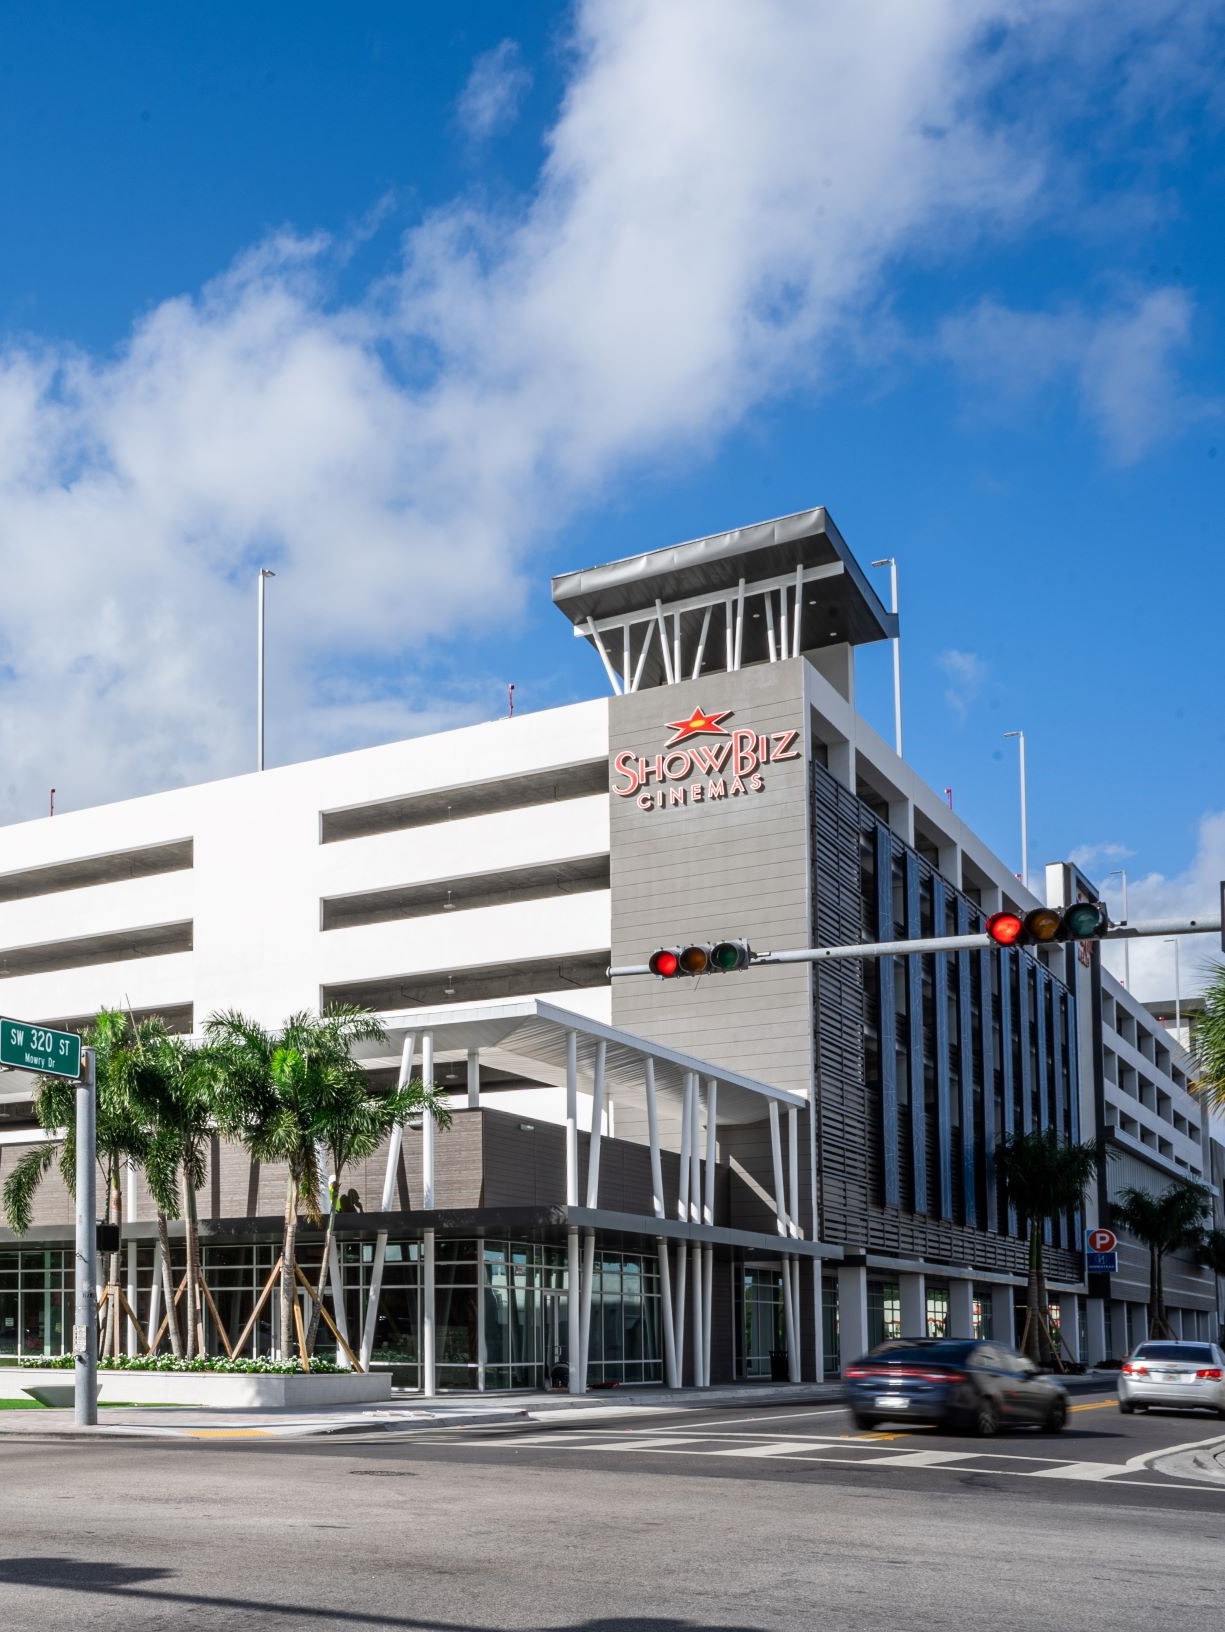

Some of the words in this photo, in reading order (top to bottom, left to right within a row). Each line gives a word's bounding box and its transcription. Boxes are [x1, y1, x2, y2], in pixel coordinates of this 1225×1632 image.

[637, 773, 763, 810] CINEMAS
[10, 1028, 24, 1047] SW
[30, 1029, 53, 1053] 320
[59, 1039, 70, 1056] ST
[25, 1052, 45, 1069] Mowry
[48, 1057, 56, 1069] Dr
[1096, 1233, 1110, 1249] P
